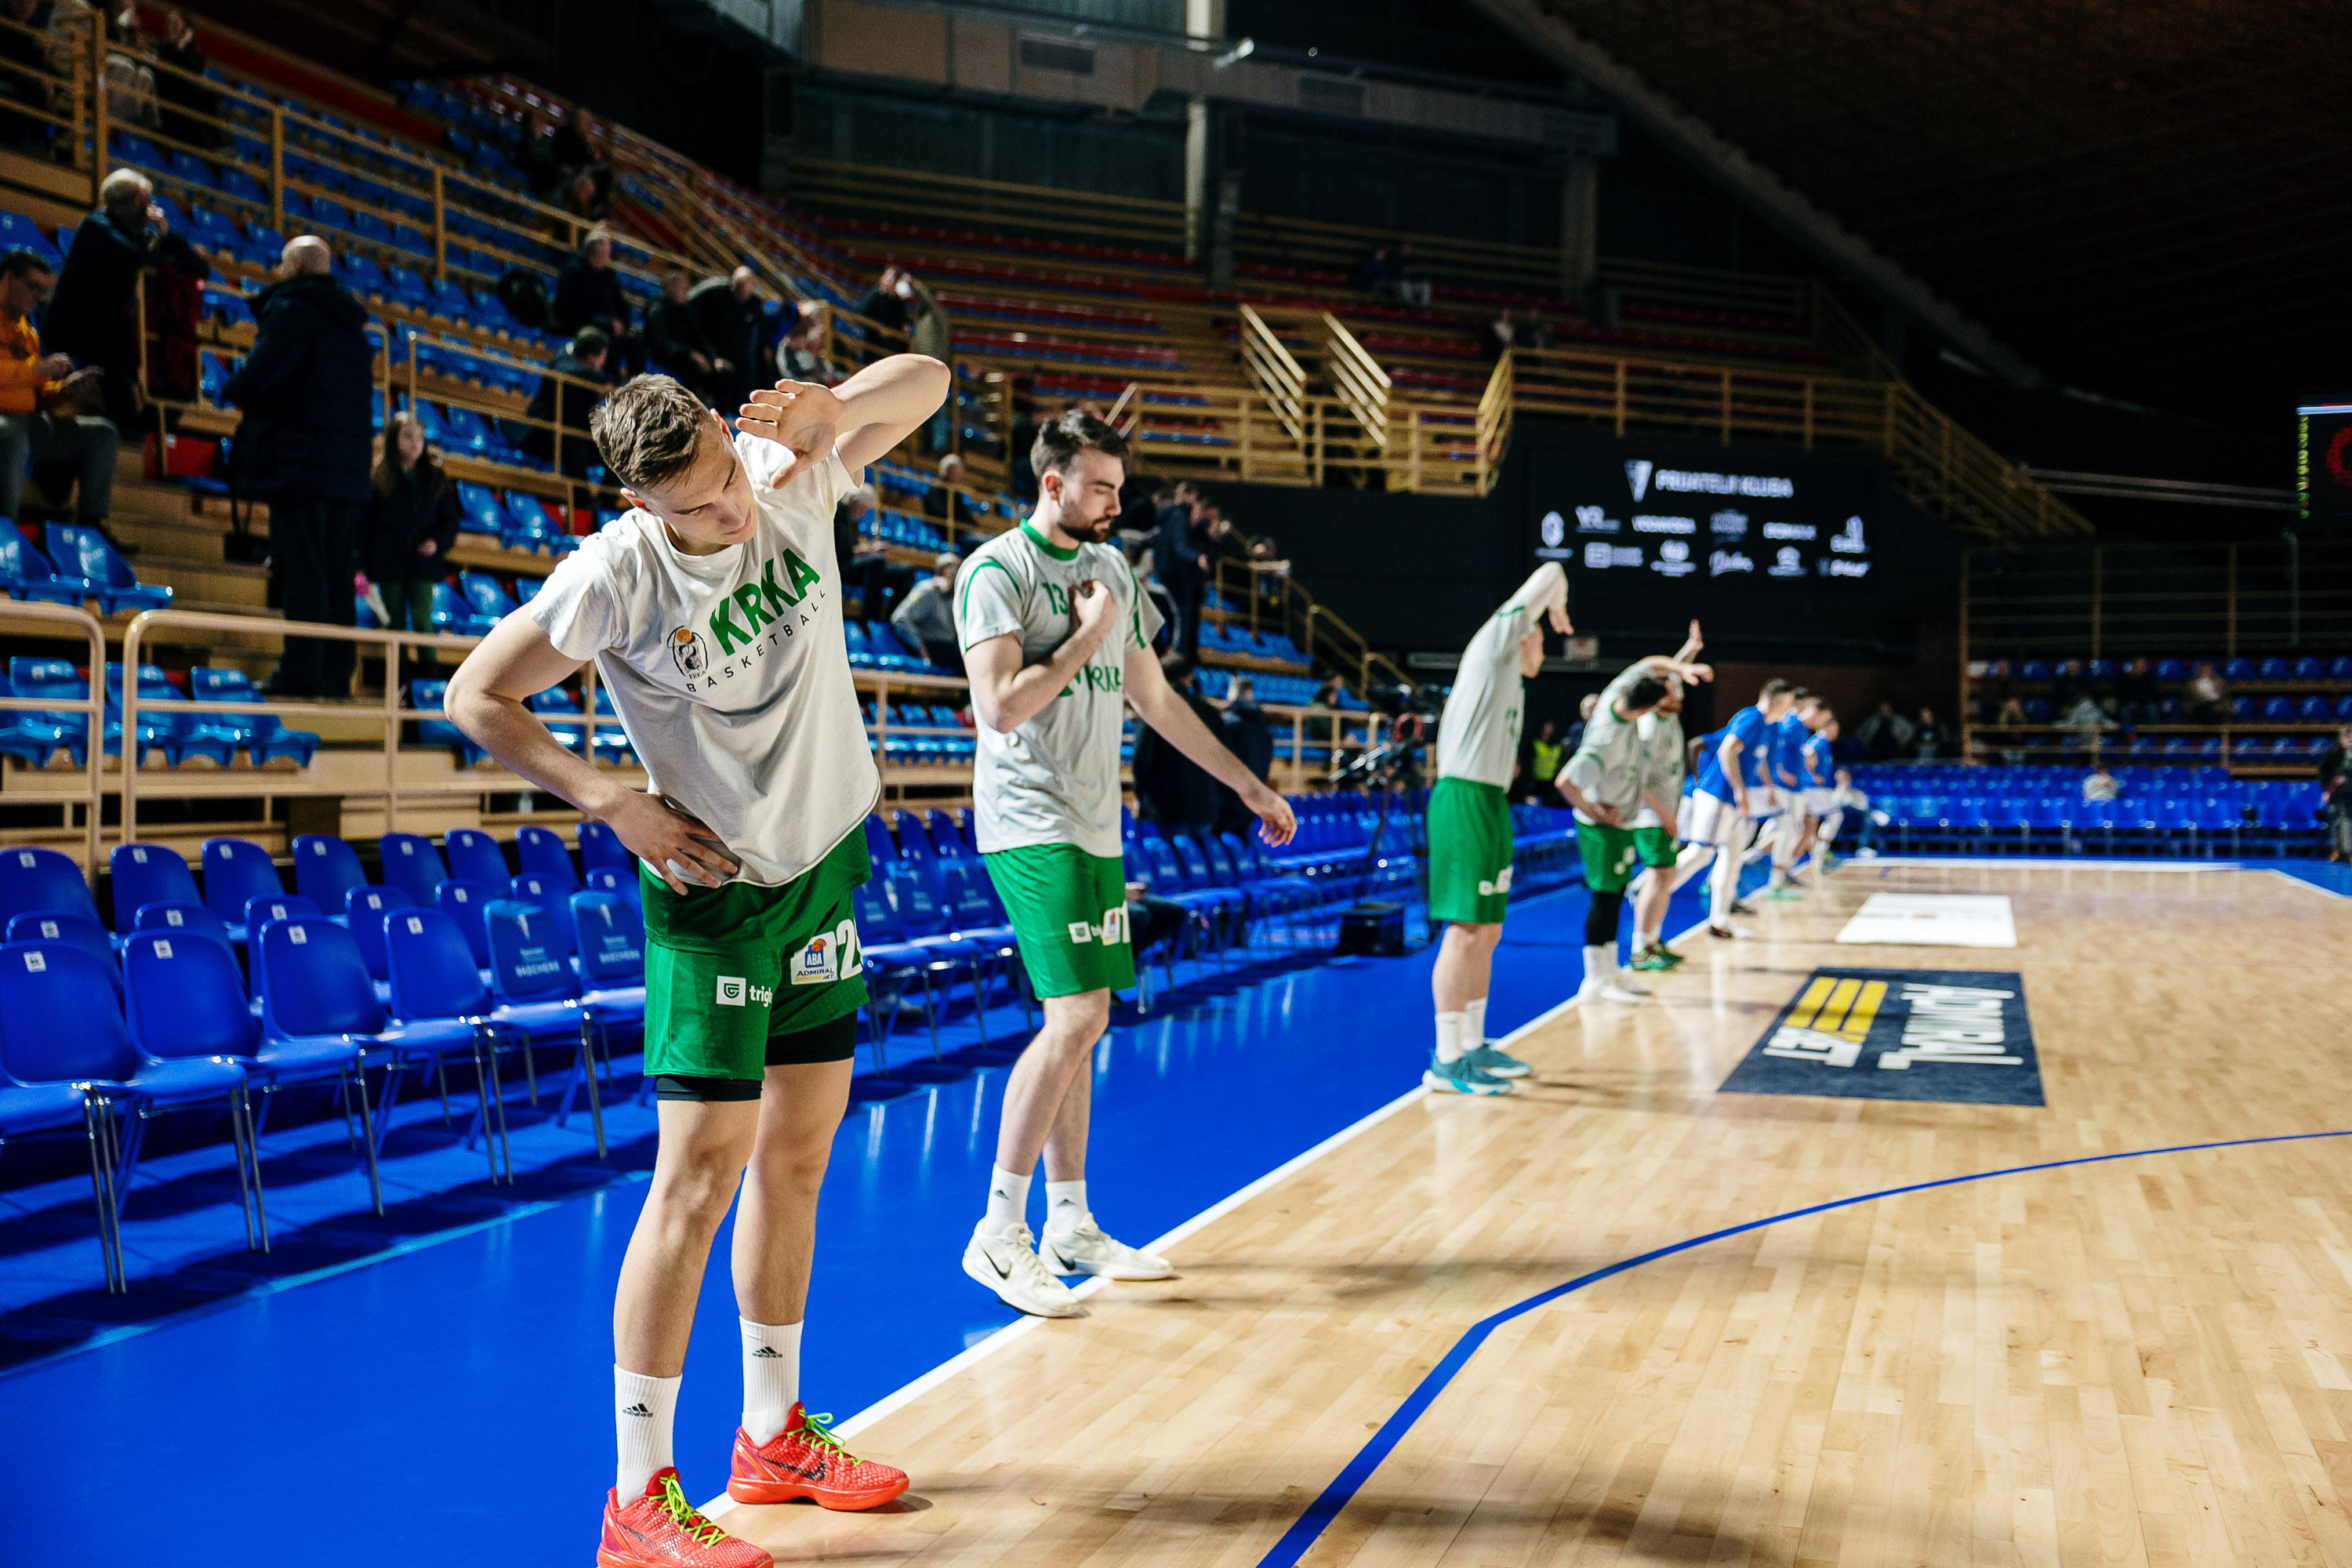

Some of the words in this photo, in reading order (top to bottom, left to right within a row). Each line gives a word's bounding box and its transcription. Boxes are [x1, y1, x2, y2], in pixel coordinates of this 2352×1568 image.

[710, 547, 820, 656] KRKA
[686, 588, 826, 692] BASKETBALL
[797, 967, 834, 977] ADMIRAL
[807, 953, 822, 967] ABA
